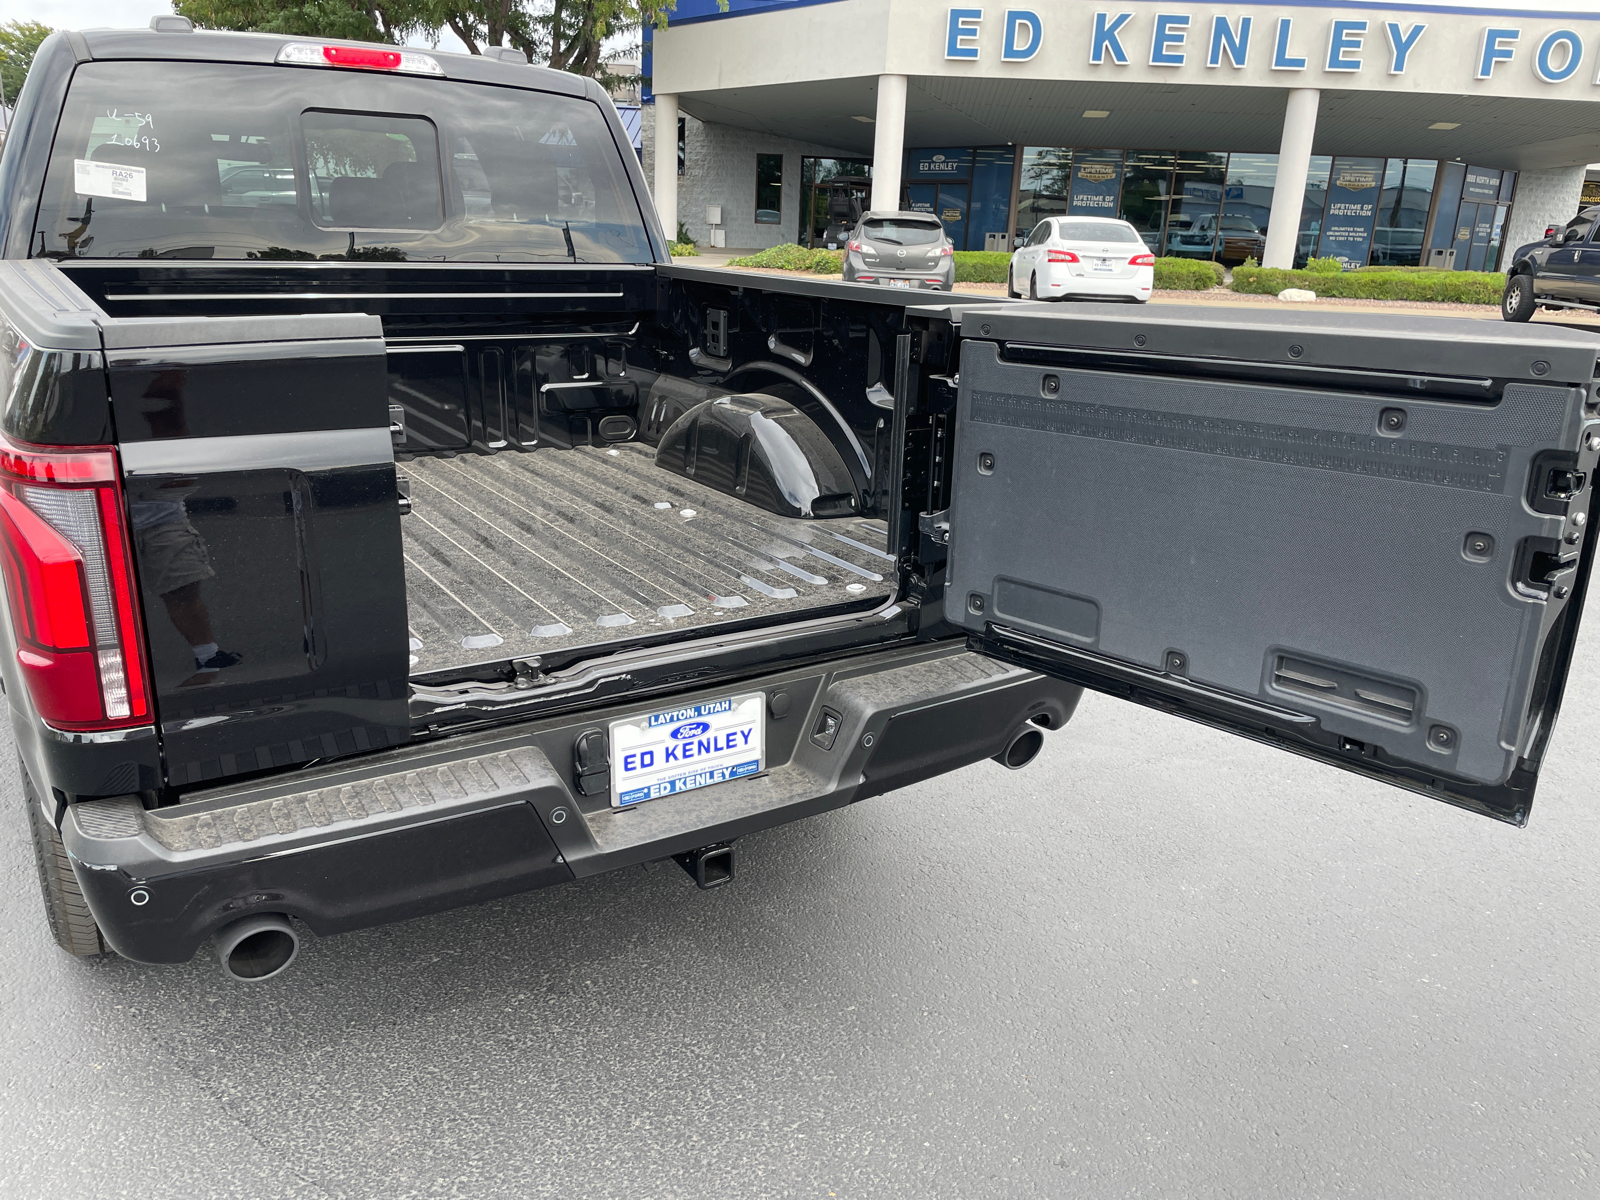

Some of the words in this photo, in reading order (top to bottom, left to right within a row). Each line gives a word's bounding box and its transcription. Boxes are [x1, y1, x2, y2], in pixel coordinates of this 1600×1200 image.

[944, 8, 1044, 62] ED
[1088, 11, 1429, 75] KENLEY
[1474, 26, 1600, 85] FO
[111, 169, 134, 179] RA26
[931, 162, 957, 170] KENLEY
[651, 709, 698, 726] LAYTON,
[701, 701, 730, 715] UTAH
[677, 725, 703, 739] Ford
[624, 750, 655, 772] ED
[665, 728, 753, 763] KENLEY
[651, 784, 671, 798] ED
[675, 767, 732, 791] KENLEY
